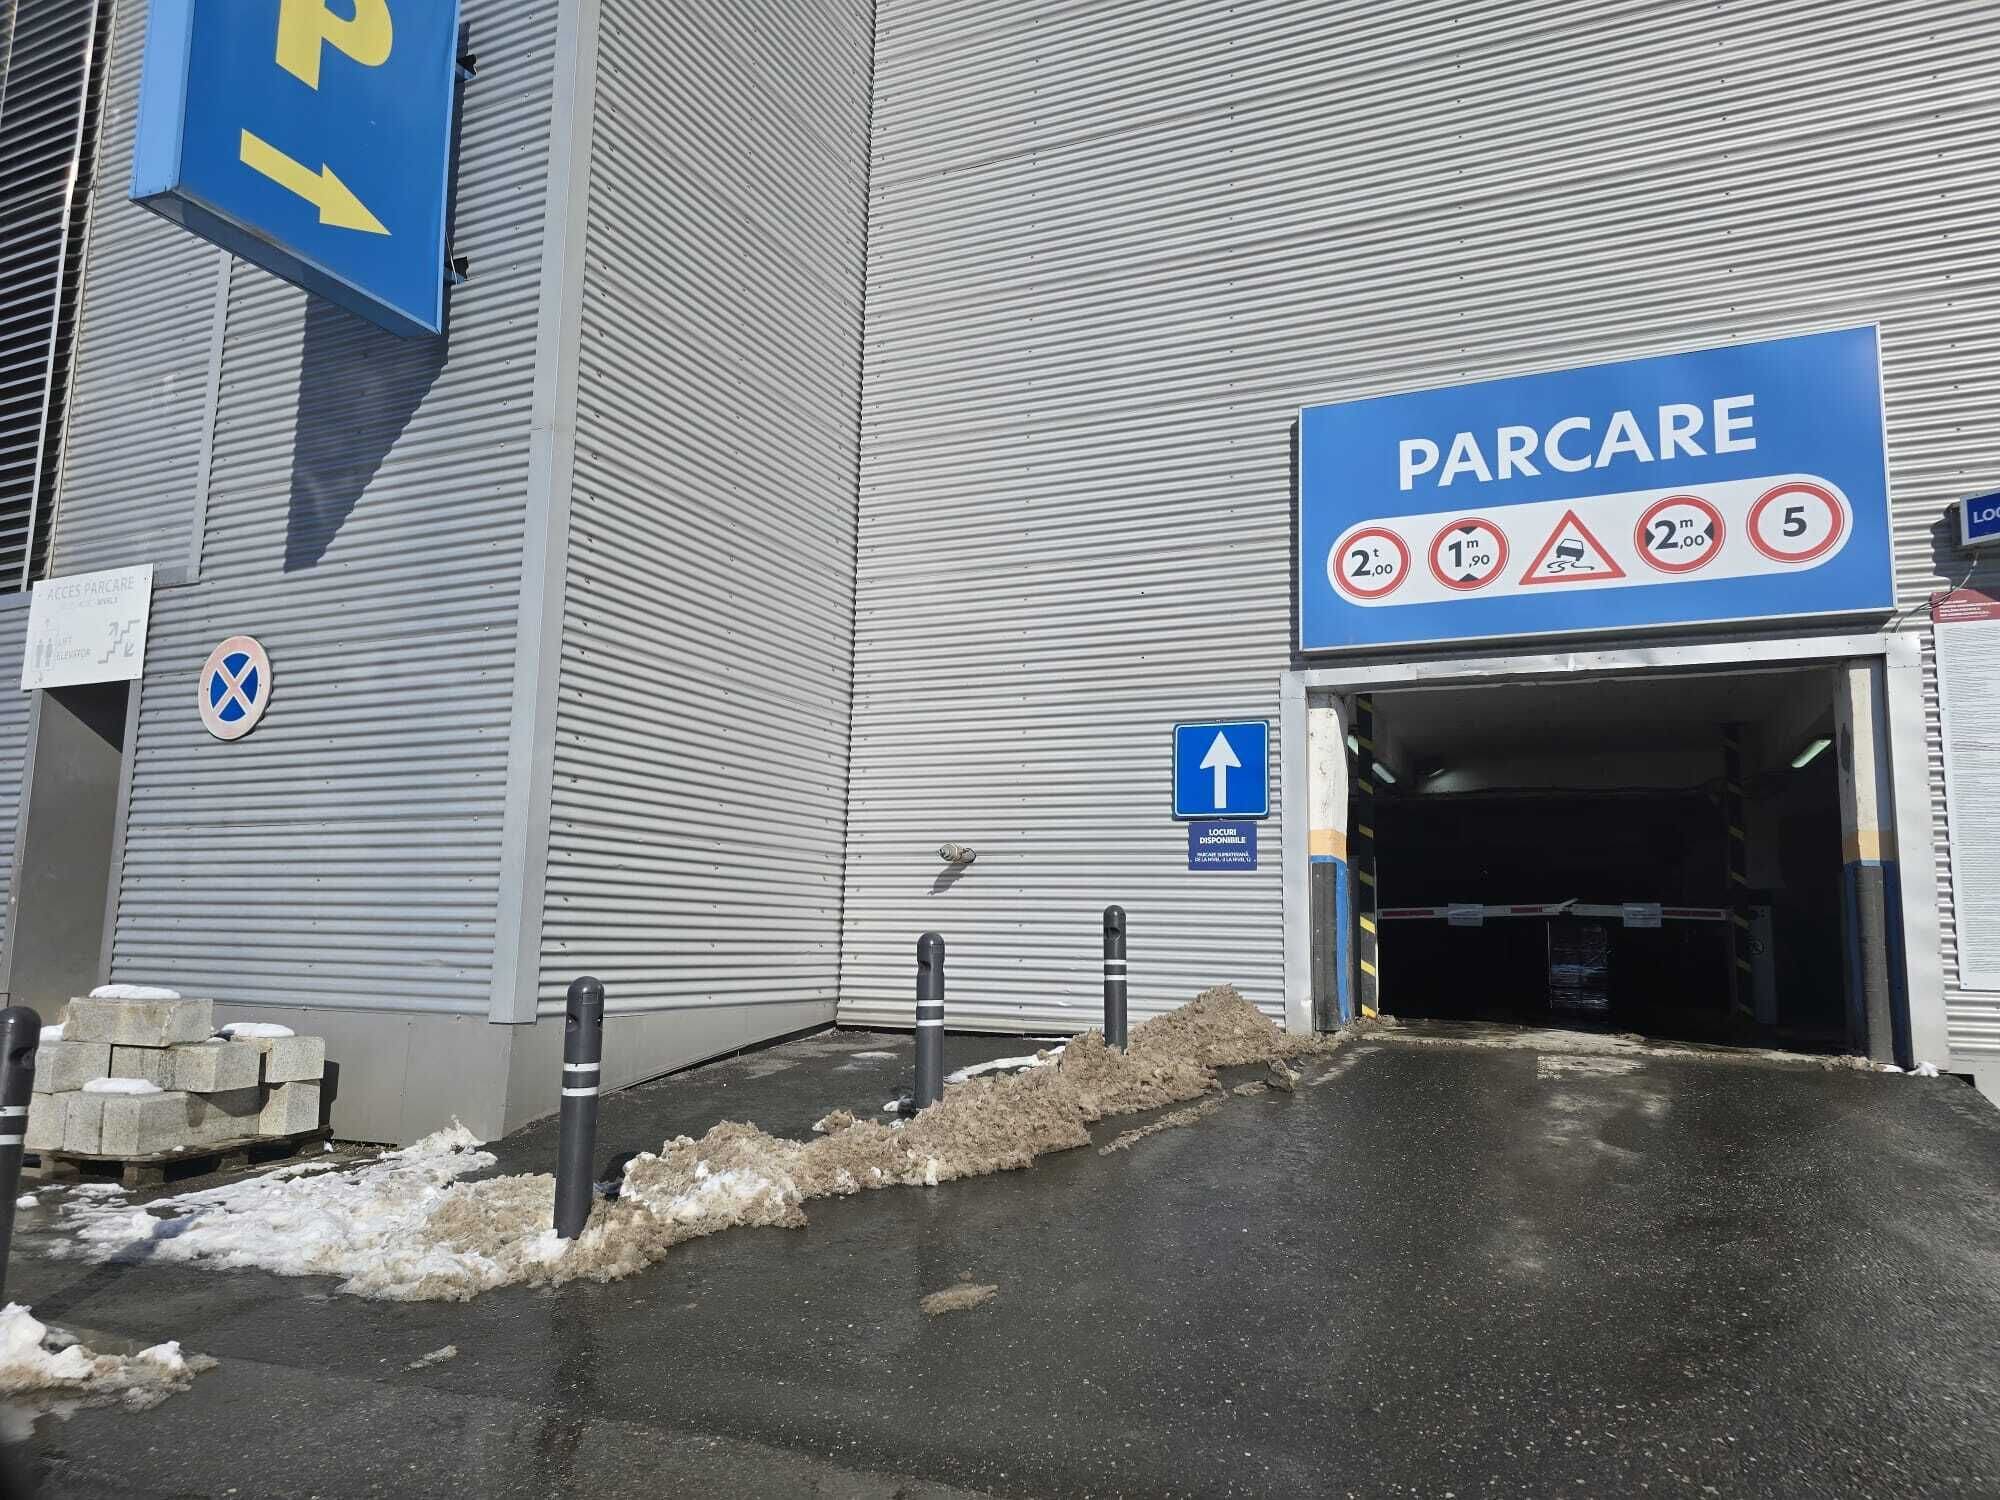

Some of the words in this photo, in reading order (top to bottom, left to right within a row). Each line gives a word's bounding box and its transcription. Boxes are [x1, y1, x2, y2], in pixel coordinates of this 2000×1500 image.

[1399, 394, 1757, 491] PARCARE
[1783, 506, 1807, 537] 5
[48, 585, 81, 600] ACCES
[84, 576, 135, 594] PARCARE
[1199, 836, 1246, 844] DISPONIBILE
[1209, 828, 1237, 836] LOCURI
